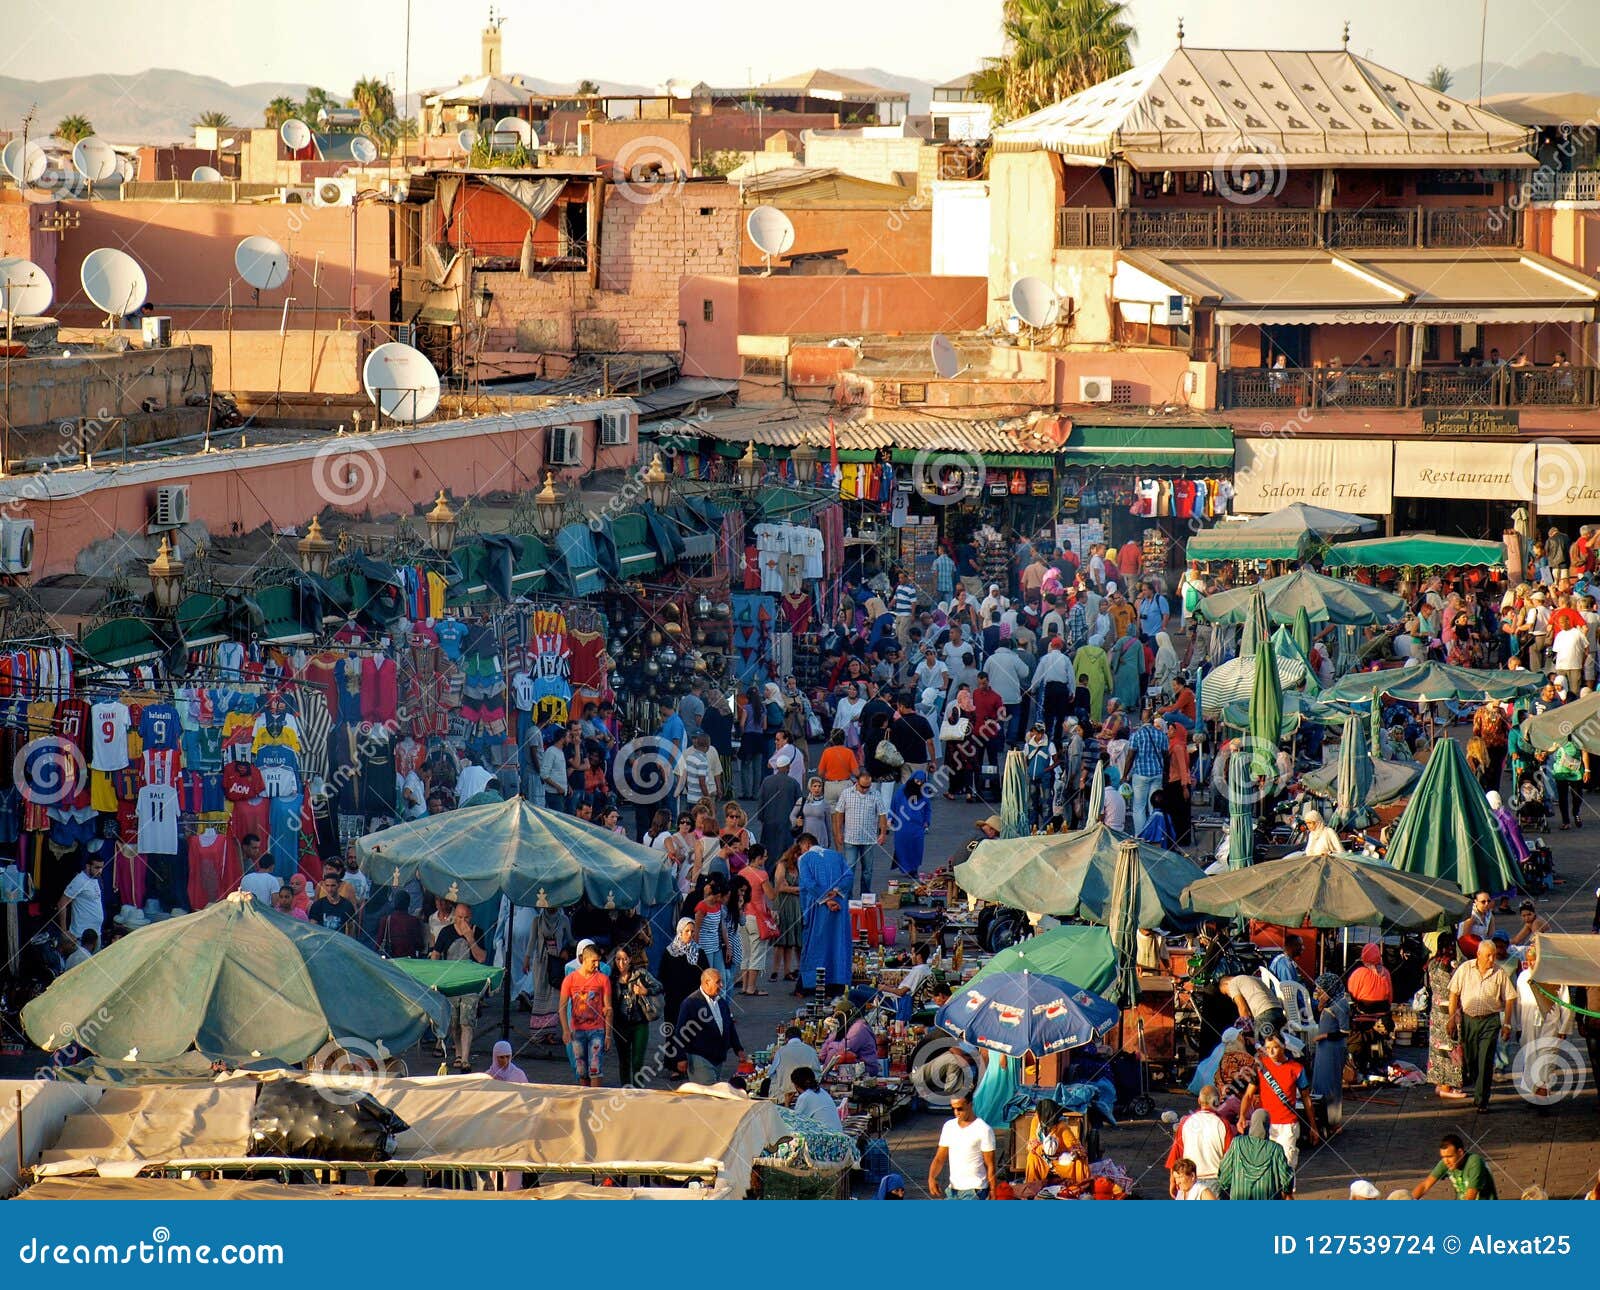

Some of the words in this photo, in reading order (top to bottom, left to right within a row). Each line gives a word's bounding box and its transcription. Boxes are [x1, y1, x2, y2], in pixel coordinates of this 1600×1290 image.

[1423, 421, 1435, 432] Les
[1469, 422, 1479, 433] de
[1420, 467, 1512, 484] Restaurant
[1258, 481, 1305, 498] Salon
[1311, 482, 1329, 497] de
[1334, 483, 1367, 498] Thé
[102, 721, 115, 744] 9
[153, 720, 166, 744] 9
[229, 782, 250, 795] AON
[268, 782, 280, 799] 11
[151, 801, 163, 822] 11
